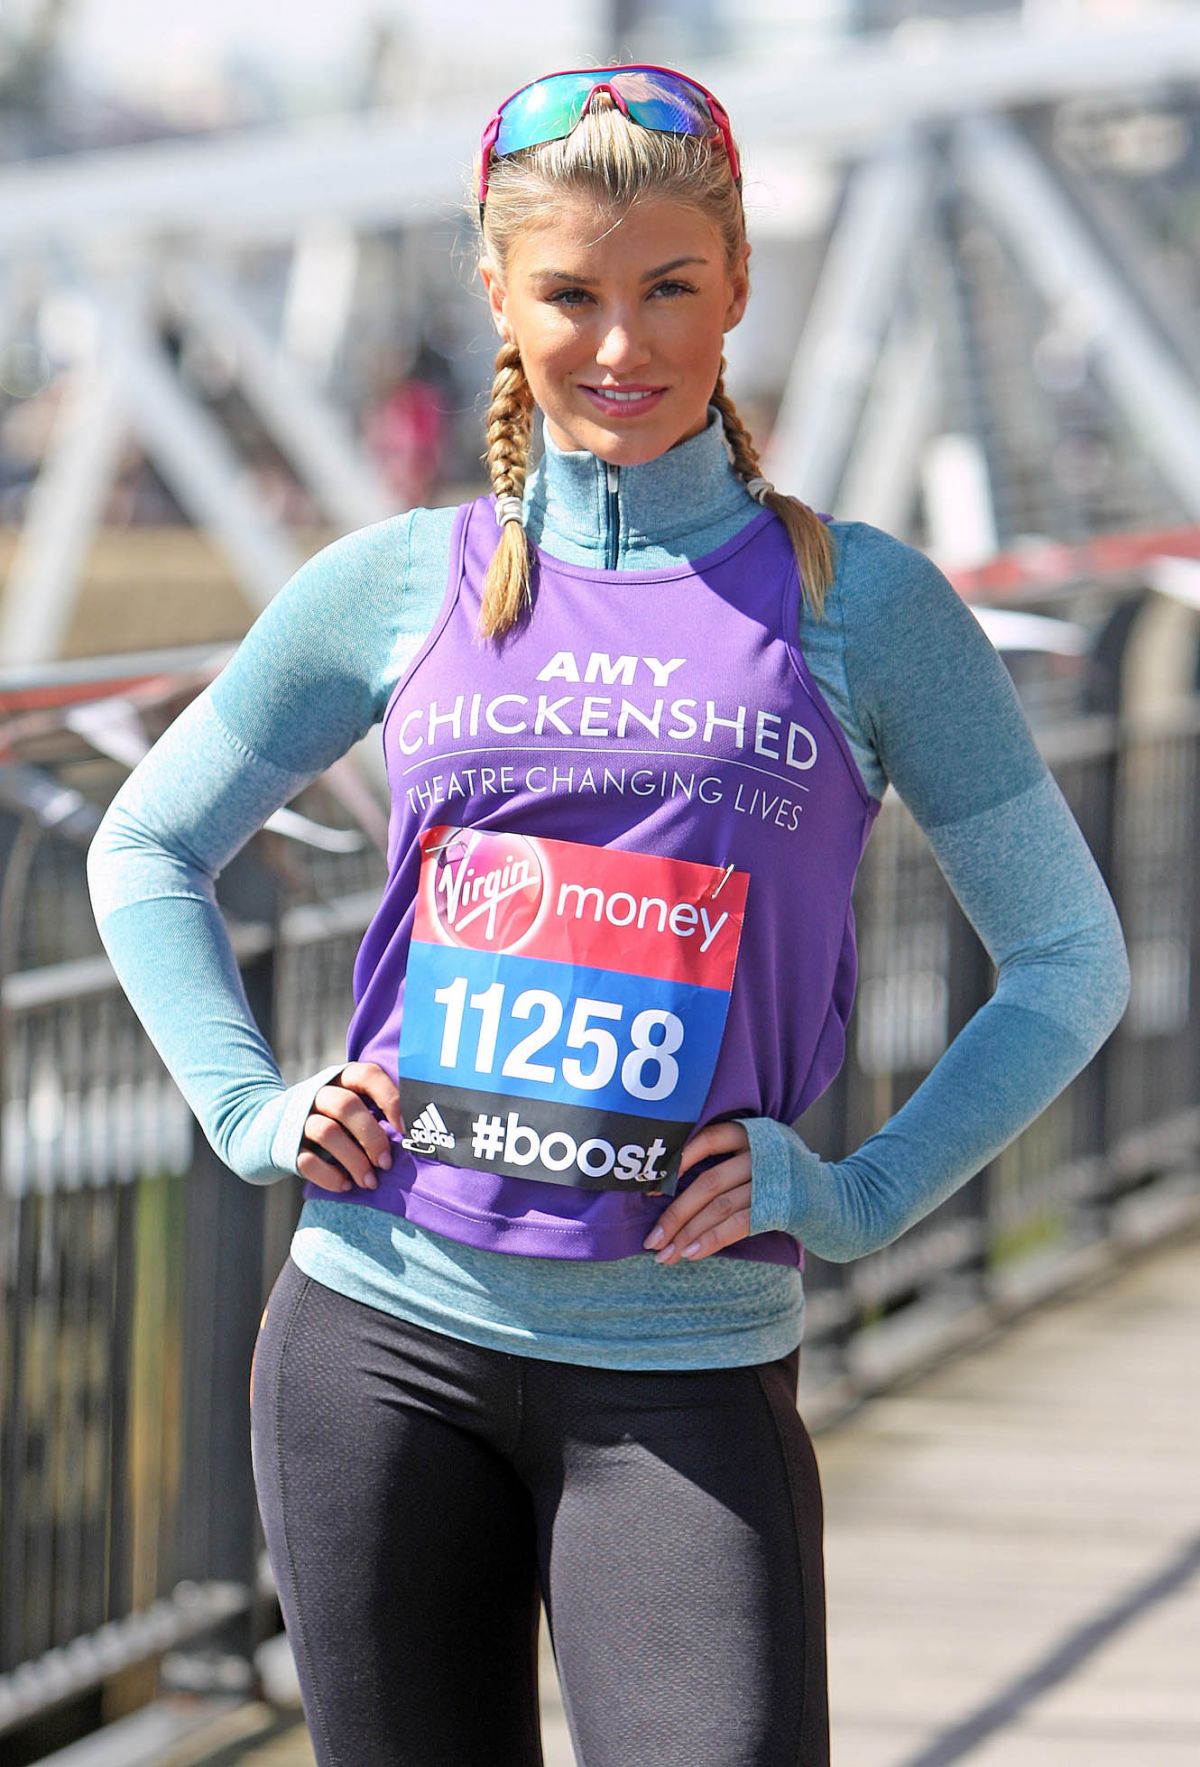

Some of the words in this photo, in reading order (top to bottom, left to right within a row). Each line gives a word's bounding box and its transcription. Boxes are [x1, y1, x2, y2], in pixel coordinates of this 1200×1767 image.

[536, 651, 688, 687] AMY
[398, 694, 818, 771] CHICKENSHED
[406, 766, 515, 815] THEATRE
[525, 766, 722, 804] CHANGING
[734, 783, 803, 832] LIVES
[438, 832, 540, 941] Virgin
[556, 882, 728, 953] money
[434, 976, 685, 1101] 11258
[410, 1127, 456, 1150] adidas
